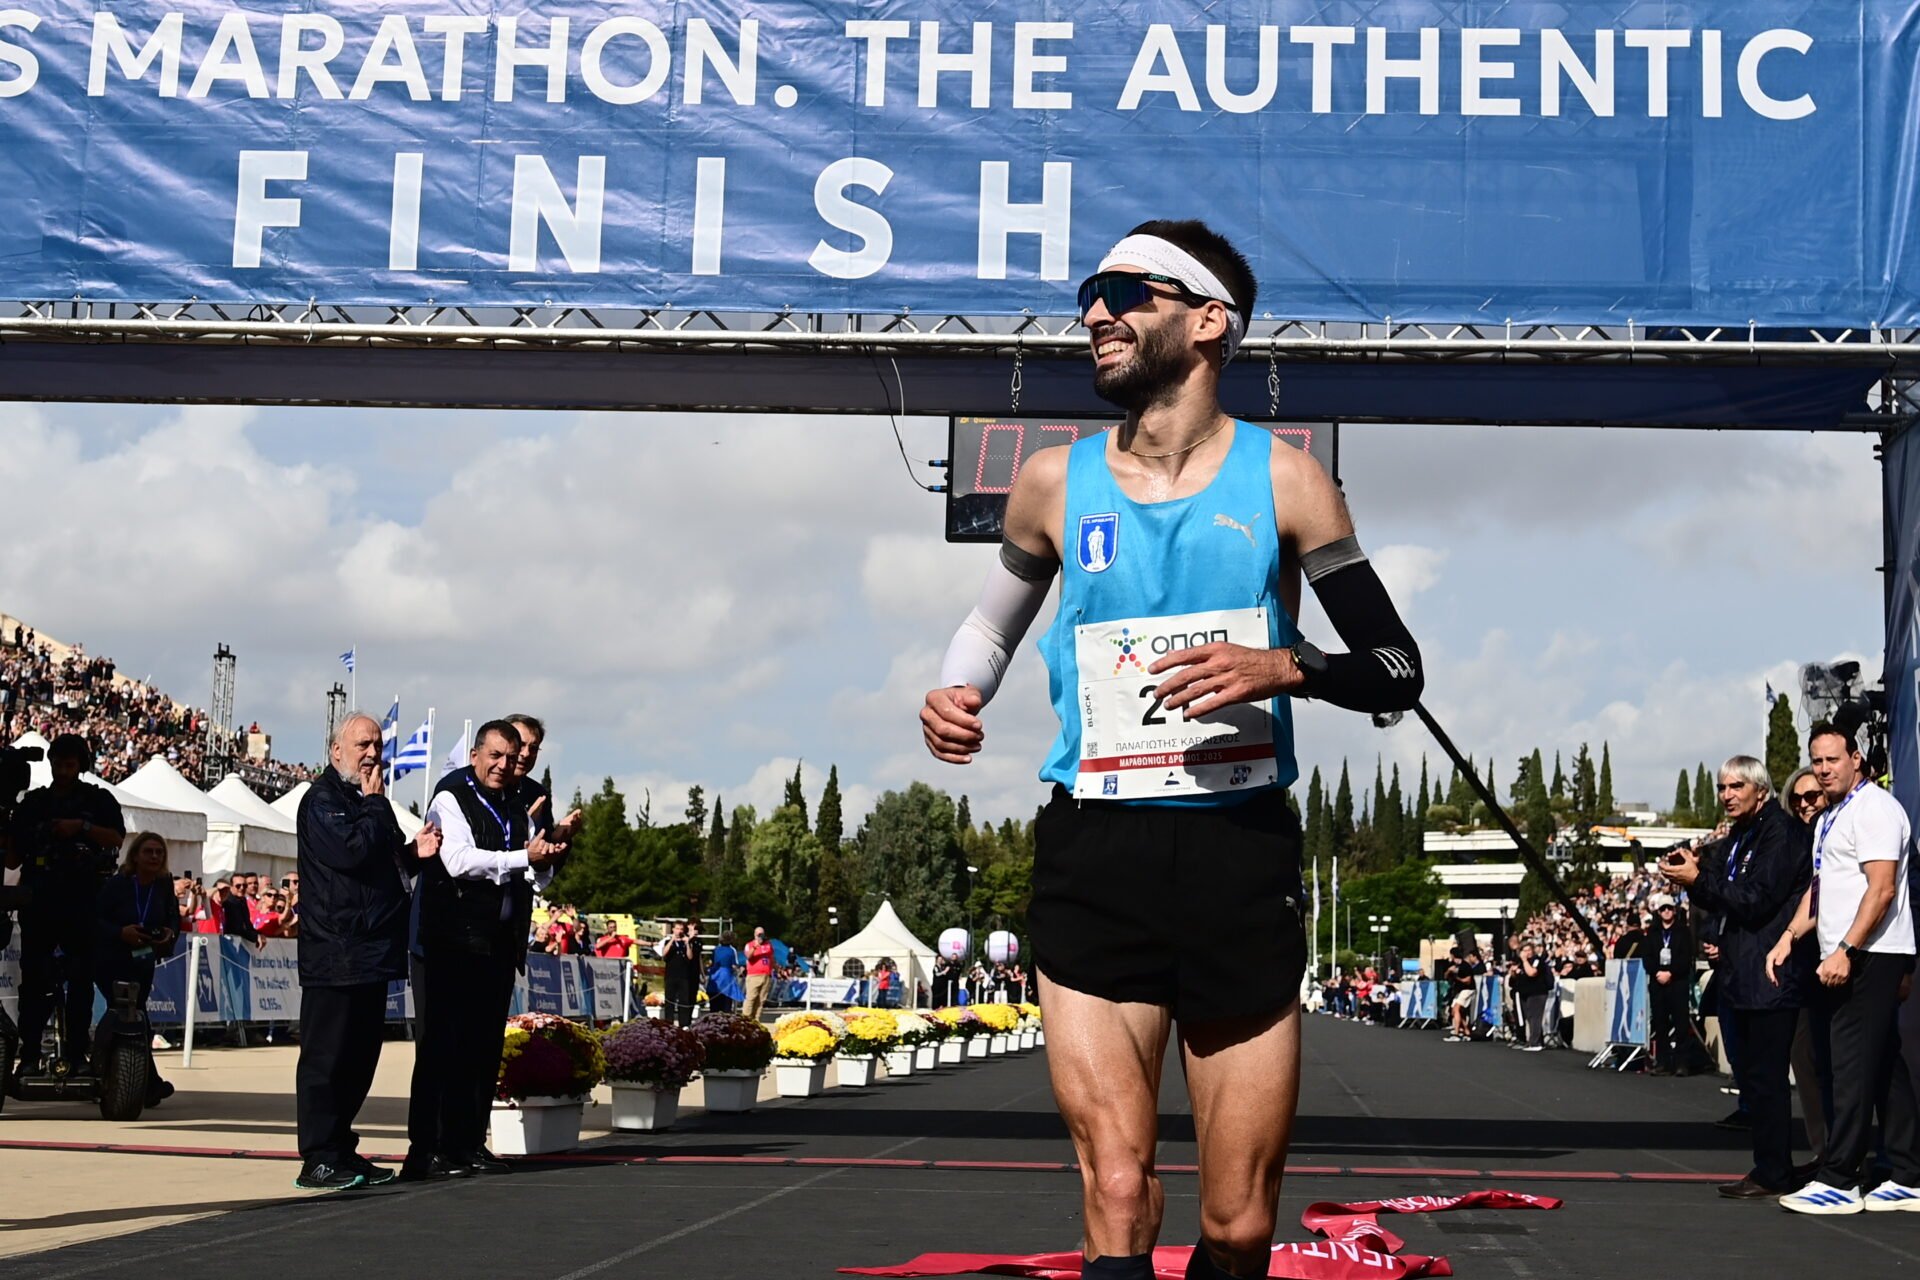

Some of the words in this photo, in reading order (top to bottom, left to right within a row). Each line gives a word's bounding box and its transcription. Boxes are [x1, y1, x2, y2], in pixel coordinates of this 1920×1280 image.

[87, 11, 798, 108] MARATHON.
[846, 20, 1073, 110] THE
[1117, 23, 1817, 121] AUTHENTIC
[232, 150, 1072, 281] FINISH
[1084, 694, 1094, 728] BLOCK
[1115, 738, 1178, 752] ΠΑΝΑΓΙΩΤΗΣ
[1119, 755, 1167, 768] ΜΑΡΑΘΩΝΙΟΣ
[1168, 752, 1201, 765] ΔΡΟΜΟΣ
